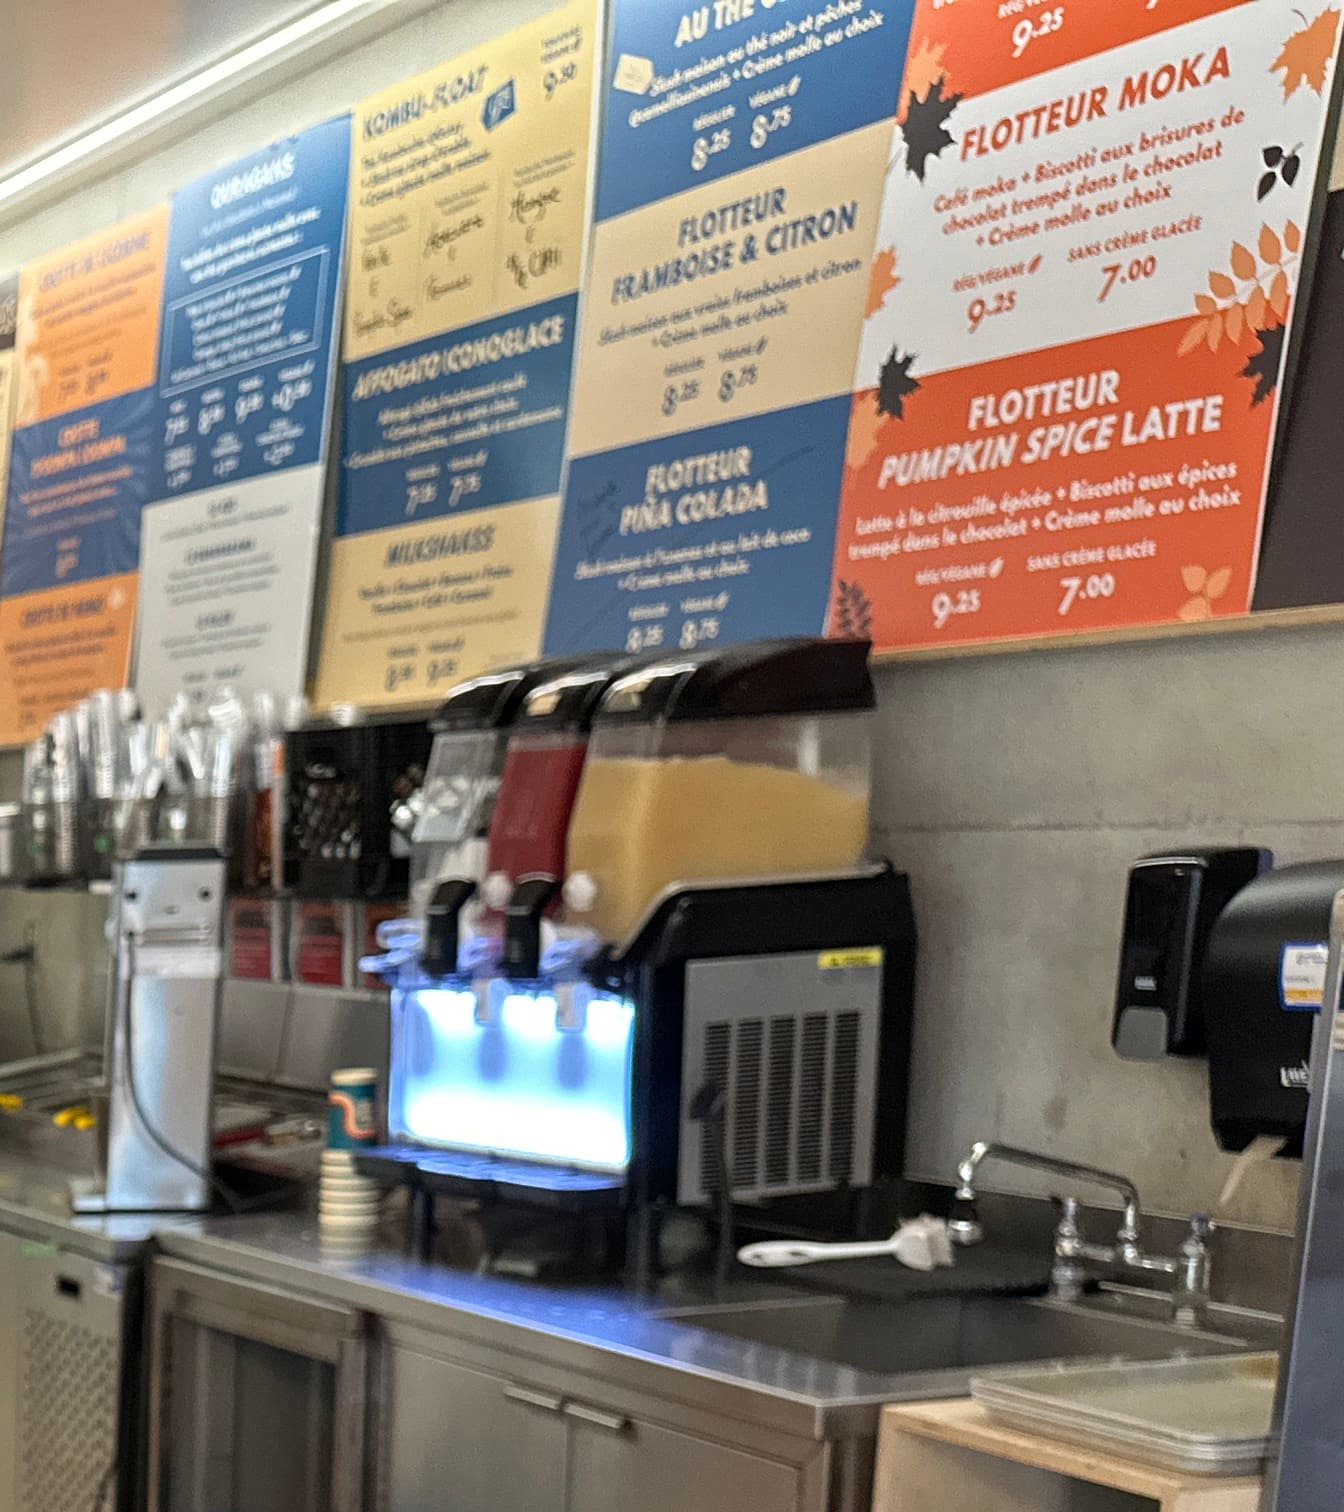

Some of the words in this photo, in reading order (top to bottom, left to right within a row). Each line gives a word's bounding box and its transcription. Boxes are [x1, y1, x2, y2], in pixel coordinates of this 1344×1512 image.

[674, 6, 709, 48] AU
[845, 9, 884, 38] choix
[1012, 8, 1064, 58] 9.25
[362, 64, 488, 141] KOMBU-FLOAT
[960, 86, 1108, 161] FLOTTEUR
[1117, 46, 1231, 112] MOKA
[691, 128, 732, 171] 8.25
[750, 104, 792, 149] 8.75
[934, 188, 969, 213] Café
[972, 177, 1016, 203] moka
[1034, 148, 1097, 184] Biscotti
[1100, 142, 1134, 164] aux
[1138, 120, 1215, 152] brisures
[1220, 105, 1246, 128] de
[678, 187, 787, 248] FLOTTEUR
[942, 202, 1008, 236] chocolat
[1012, 186, 1071, 216] trempé
[1074, 172, 1118, 198] dans
[1122, 158, 1140, 182] le
[1143, 141, 1223, 177] chocolat
[987, 218, 1040, 247] Crème
[1044, 204, 1092, 232] molle
[1095, 198, 1119, 217] au
[1123, 182, 1172, 211] choix
[611, 240, 735, 306] FRAMBOISE
[739, 234, 759, 265] &
[765, 200, 859, 256] CITRON
[1067, 241, 1101, 263] SANS
[1096, 254, 1157, 303] 7.00
[968, 290, 1018, 334] 9.25
[352, 351, 442, 401] AFFOGATO
[968, 370, 1120, 432] FLOTTEUR
[645, 446, 752, 495] FLOTTEUR
[877, 434, 1017, 490] PUMPKIN
[1020, 413, 1118, 466] SPICE
[1121, 394, 1224, 447] LATTE
[619, 491, 672, 536] PIÑA
[676, 480, 769, 526] COLADA
[927, 492, 998, 524] citrouille
[1069, 474, 1135, 501] Biscotti
[1137, 471, 1174, 493] aux
[1177, 459, 1238, 489] épices
[960, 515, 1029, 546] chocolat
[1044, 504, 1100, 533] Crème
[1104, 495, 1154, 524] molle
[1158, 493, 1185, 515] au
[1188, 483, 1242, 510] choix
[931, 590, 981, 630] 9.25
[1058, 573, 1115, 616] 7.00
